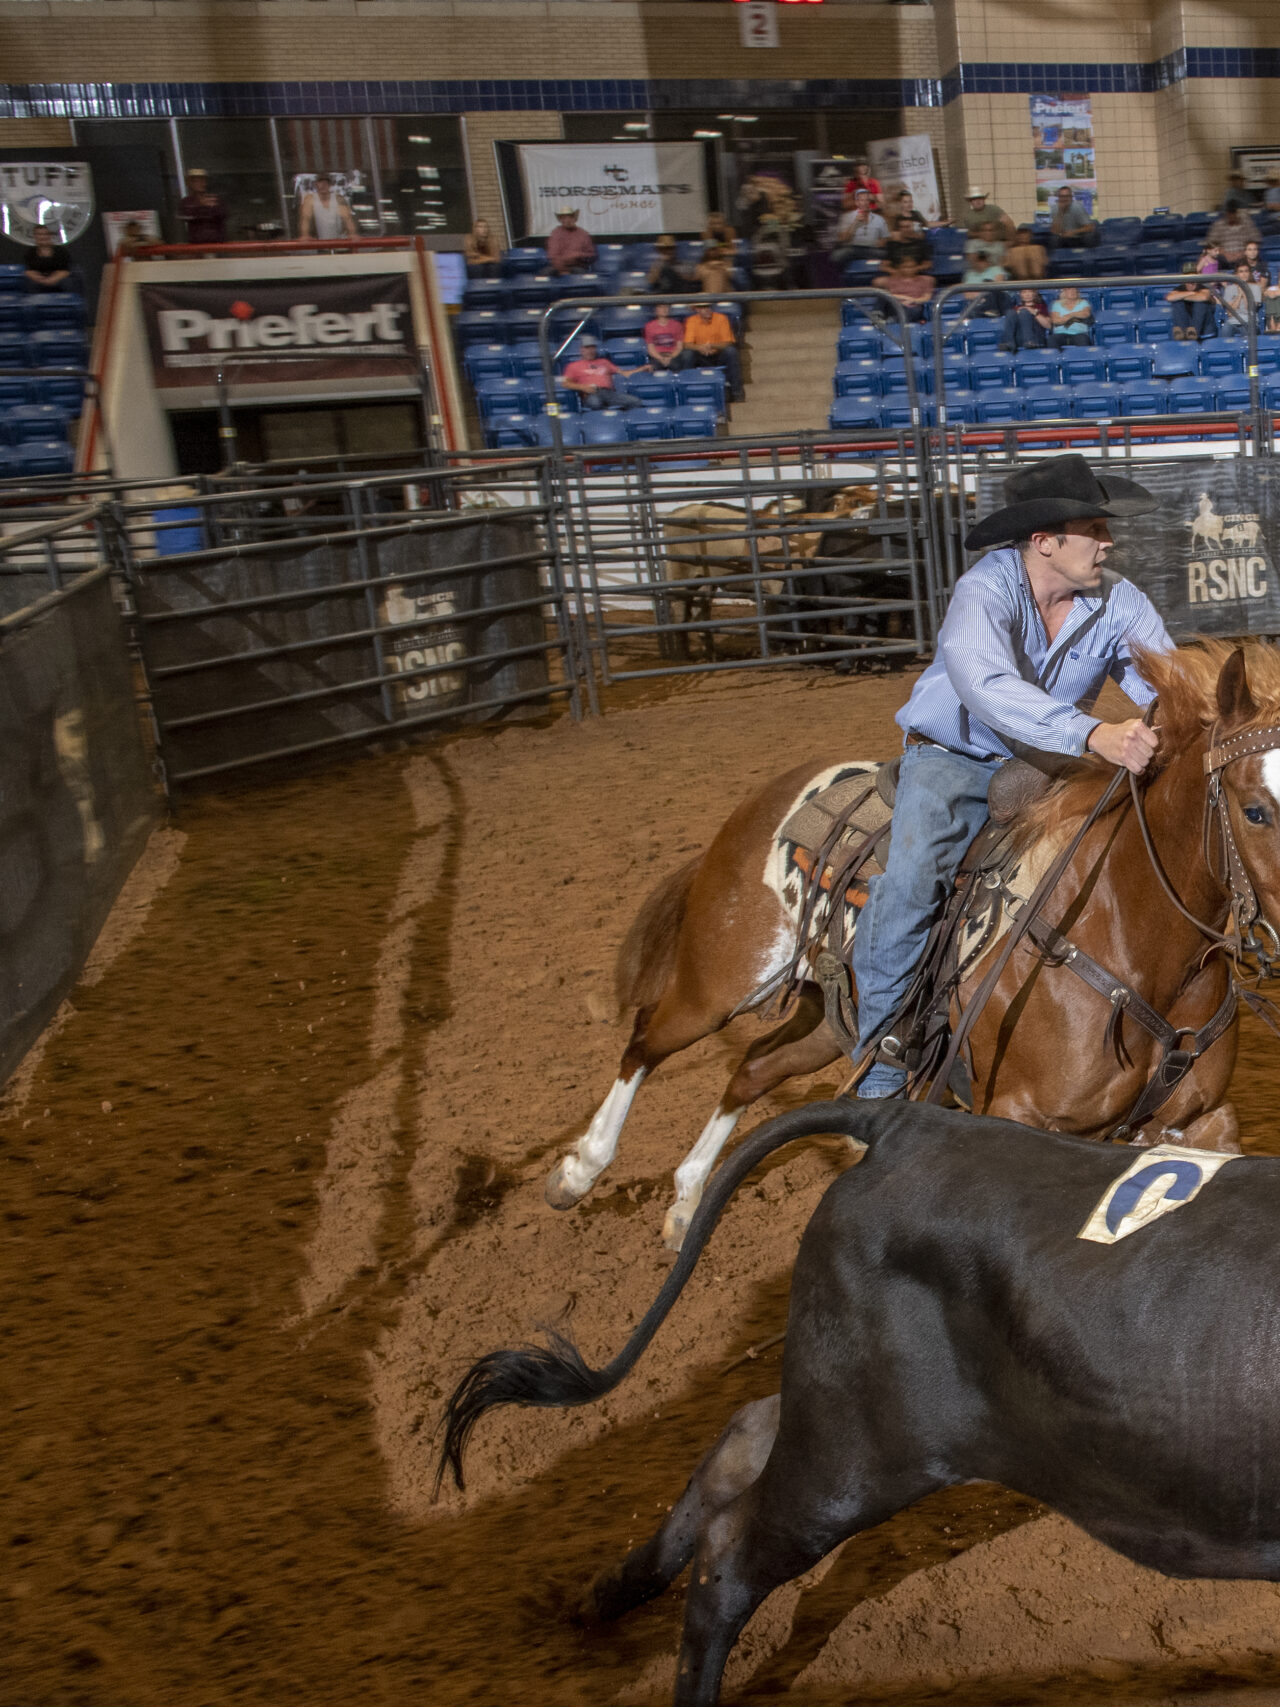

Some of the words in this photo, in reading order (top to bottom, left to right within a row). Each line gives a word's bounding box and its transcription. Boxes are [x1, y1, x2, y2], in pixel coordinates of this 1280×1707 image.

[751, 13, 768, 35] 2
[158, 303, 404, 350] Priefert
[1188, 556, 1267, 603] RSNC
